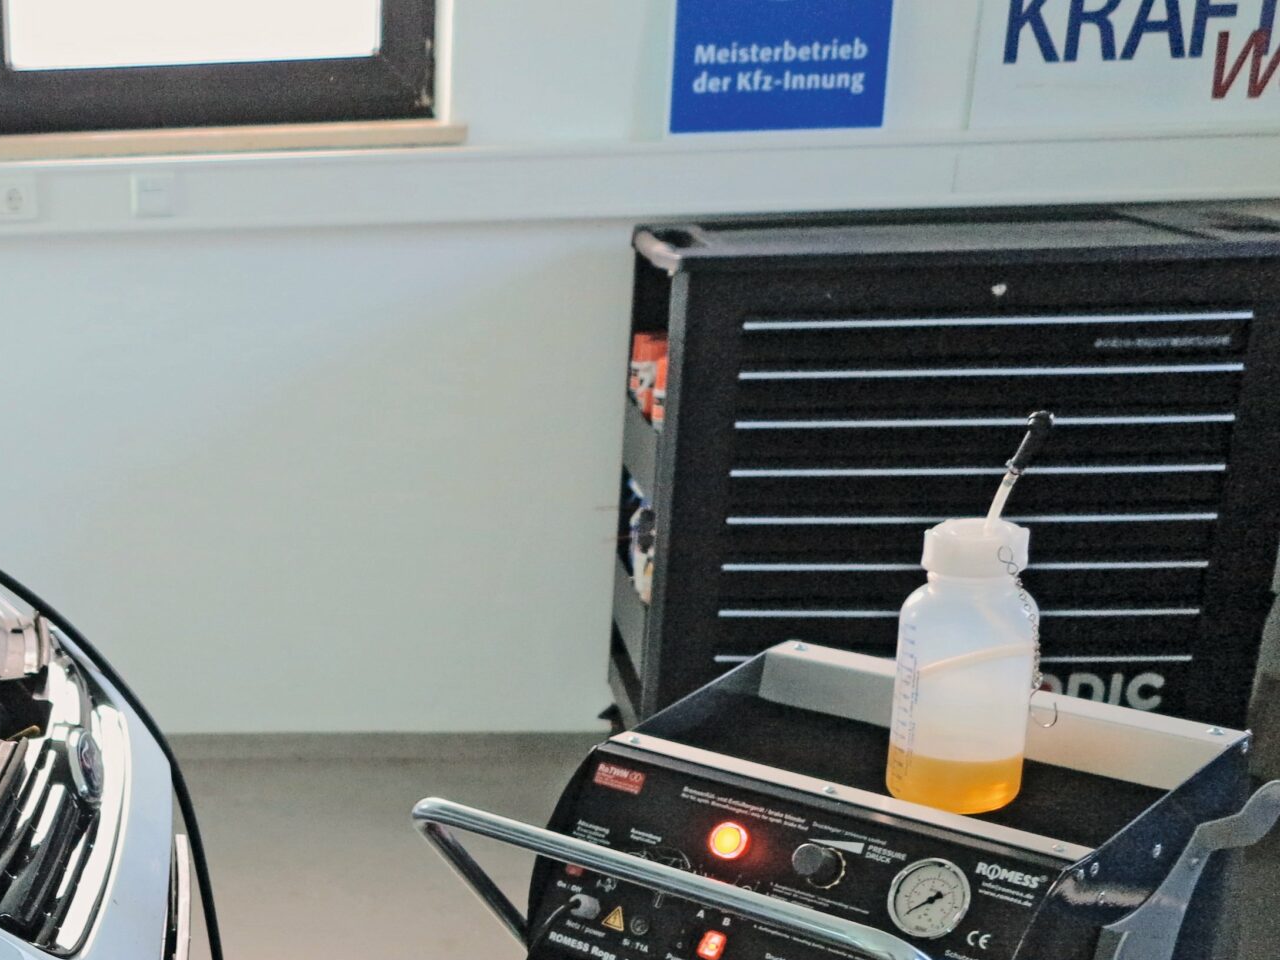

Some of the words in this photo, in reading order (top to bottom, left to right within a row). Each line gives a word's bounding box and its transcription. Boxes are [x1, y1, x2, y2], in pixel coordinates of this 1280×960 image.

[694, 37, 868, 65] Meisterbetrieb
[693, 71, 731, 94] der
[736, 69, 866, 95] Kfz-Innung
[865, 851, 892, 864] DRUCK
[867, 844, 907, 862] PRESSURE
[696, 909, 705, 919] A
[722, 917, 731, 926] B
[584, 927, 606, 938] power
[548, 931, 591, 951] ROMESS
[590, 946, 617, 960] Rogg
